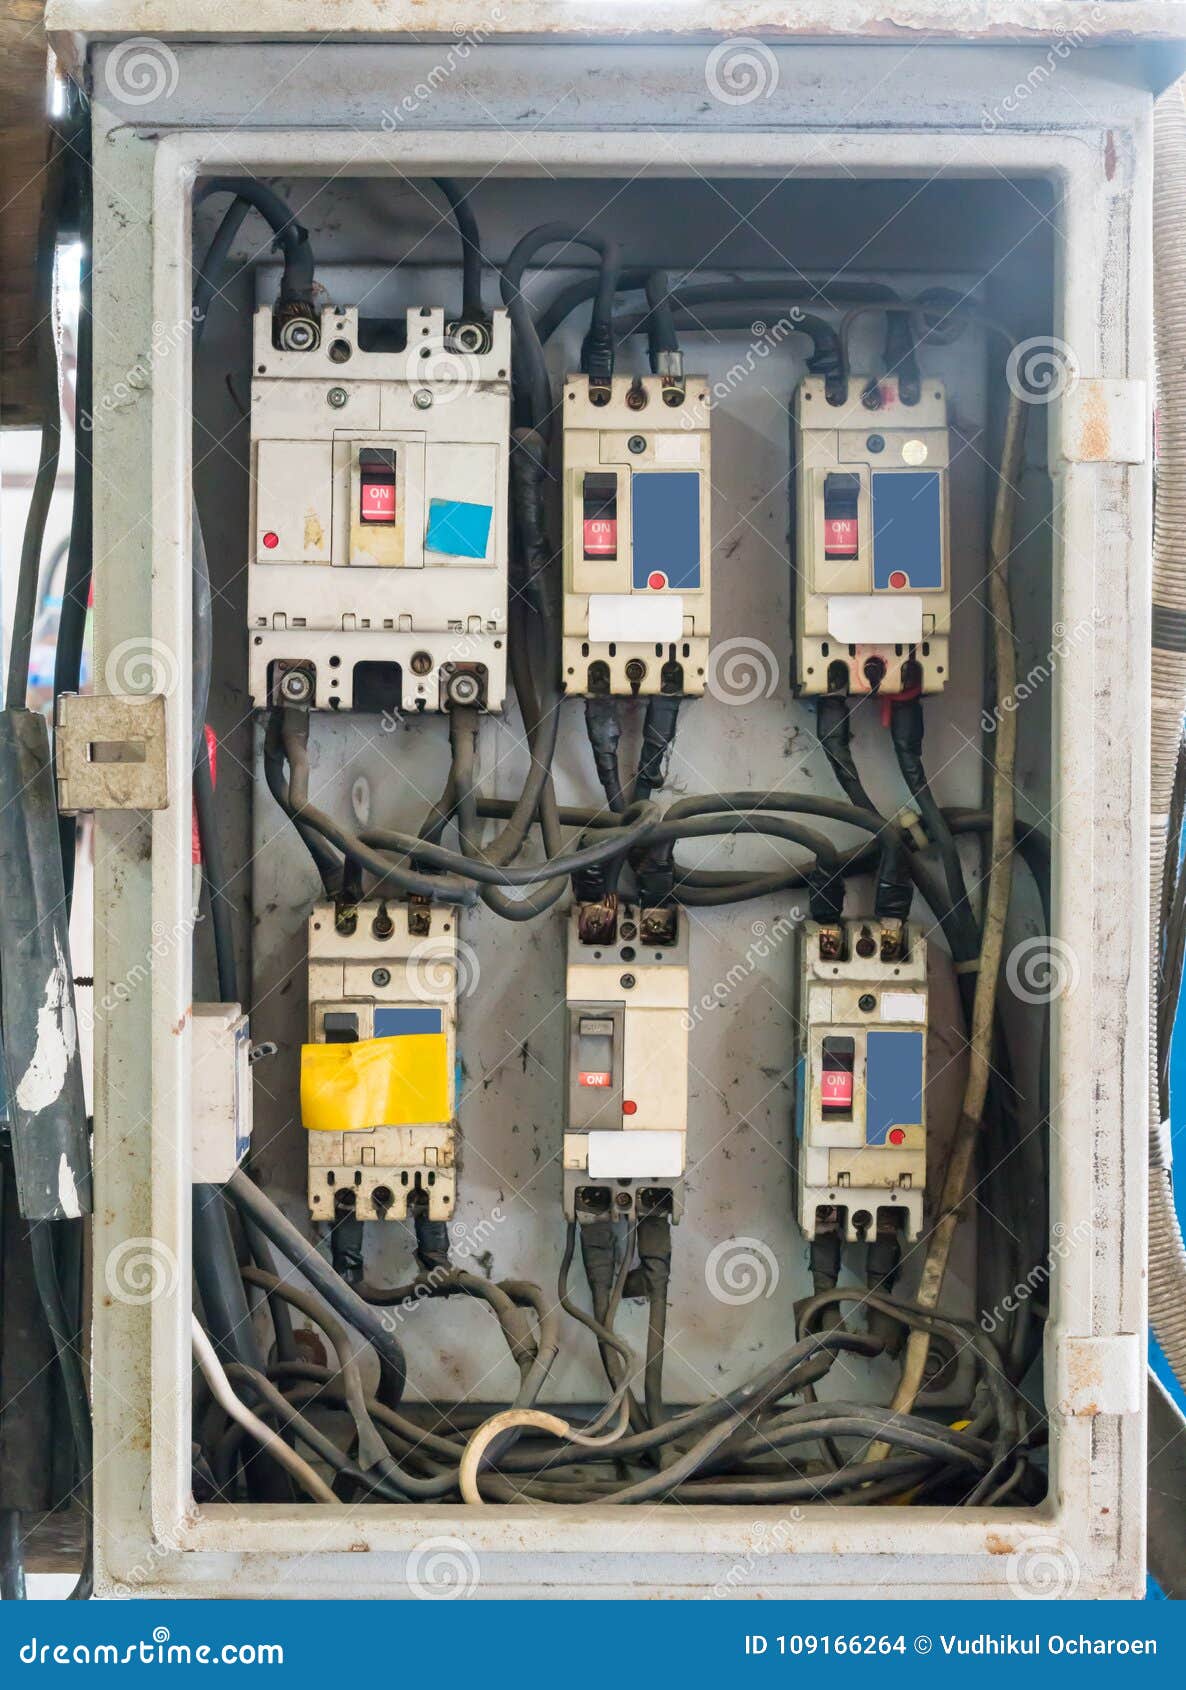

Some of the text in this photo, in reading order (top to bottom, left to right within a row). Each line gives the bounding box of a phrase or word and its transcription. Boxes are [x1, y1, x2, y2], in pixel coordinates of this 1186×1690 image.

[370, 488, 389, 498] ON
[591, 523, 611, 533] ON
[832, 522, 851, 533] ON
[586, 1076, 604, 1085] ON
[827, 1075, 846, 1086] ON
